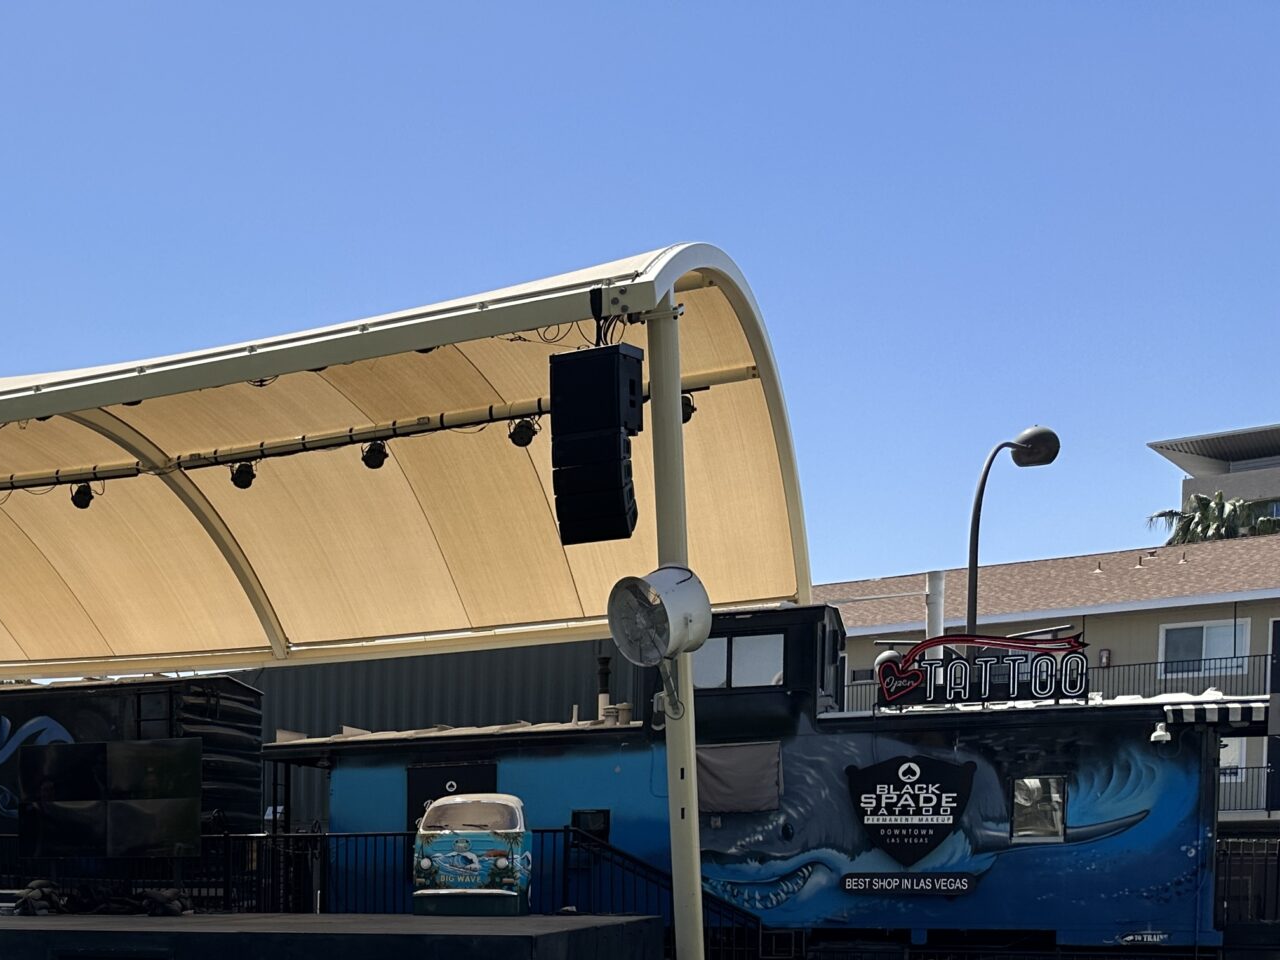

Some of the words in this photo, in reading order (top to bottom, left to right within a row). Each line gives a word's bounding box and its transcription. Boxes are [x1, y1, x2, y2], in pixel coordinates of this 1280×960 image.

[885, 676, 915, 692] Open
[921, 654, 1087, 701] TATTOO
[876, 784, 941, 795] BLACK
[860, 793, 957, 807] SPADE
[864, 807, 951, 815] TATTOO
[845, 878, 871, 890] BEST
[872, 878, 899, 890] SHOP
[901, 878, 911, 890] IN
[913, 878, 932, 890] LAS
[934, 878, 968, 890] VEGAS
